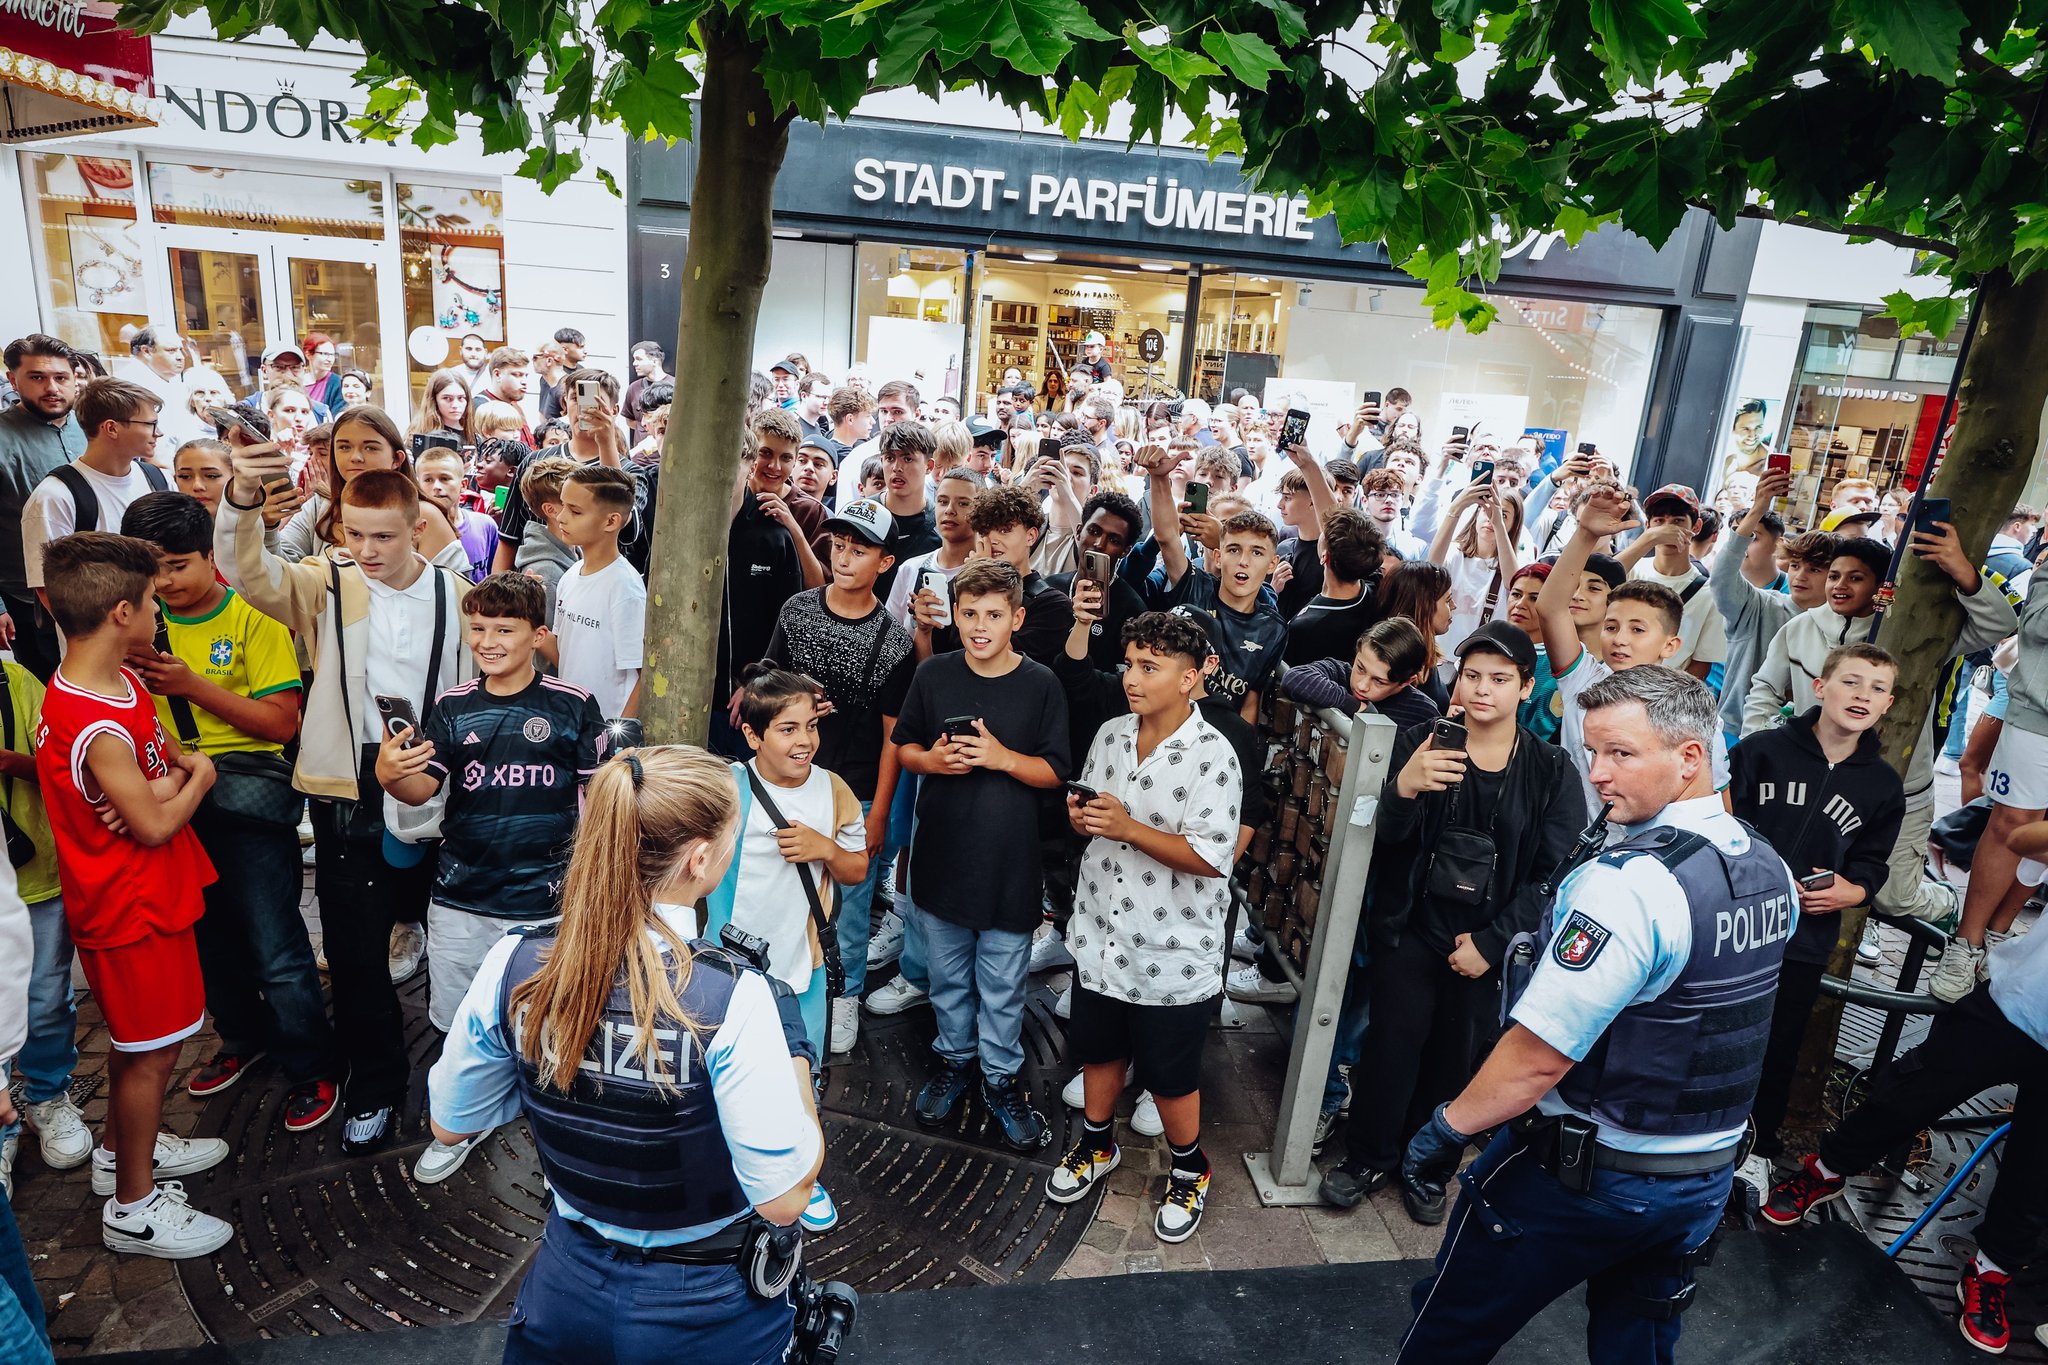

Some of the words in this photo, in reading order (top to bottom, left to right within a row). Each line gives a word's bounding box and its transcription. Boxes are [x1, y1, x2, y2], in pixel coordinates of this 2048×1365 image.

[0, 0, 87, 38] macht
[1029, 176, 1314, 240] PARFÜMERIE
[660, 263, 671, 279] 3
[1053, 288, 1081, 297] ACQUA
[205, 668, 234, 676] BRASIL
[1990, 769, 2010, 796] 13
[1572, 914, 1607, 942] POLIZEI
